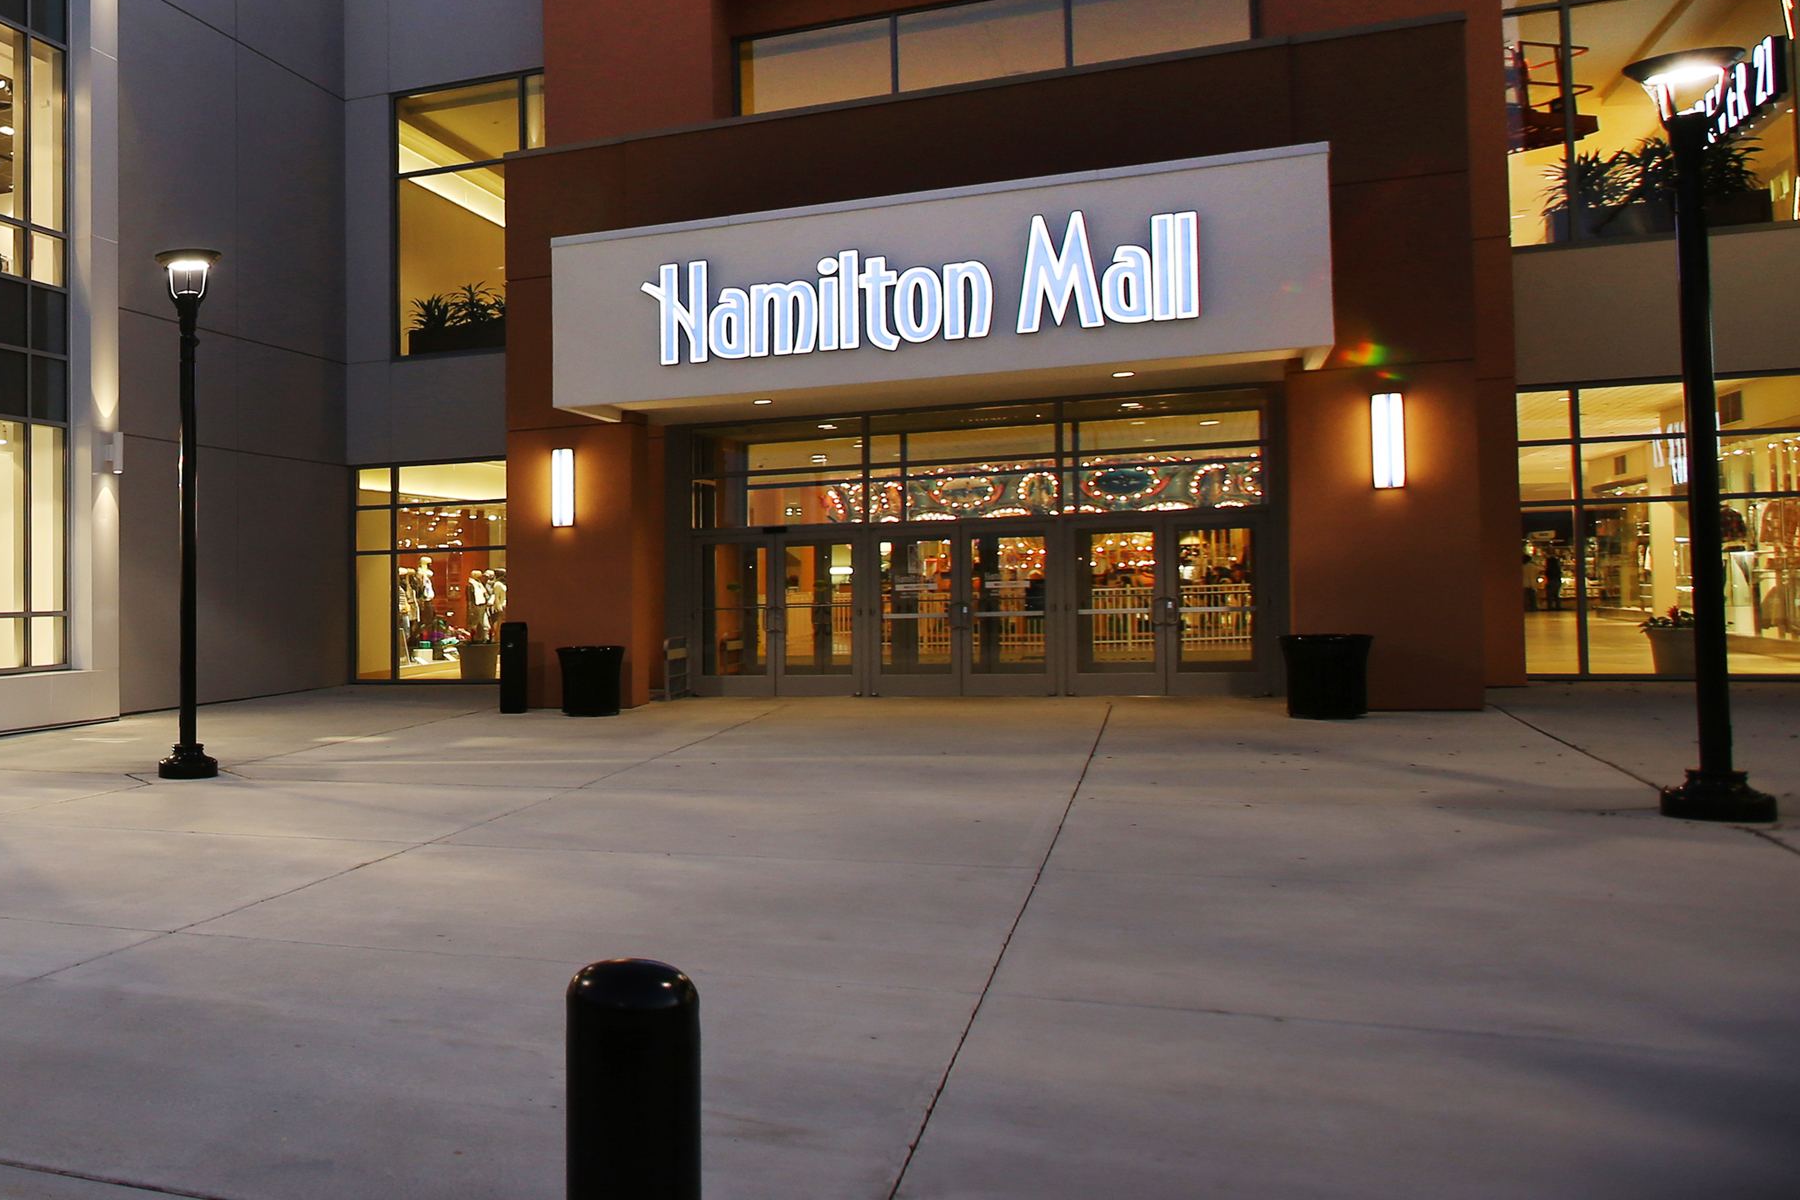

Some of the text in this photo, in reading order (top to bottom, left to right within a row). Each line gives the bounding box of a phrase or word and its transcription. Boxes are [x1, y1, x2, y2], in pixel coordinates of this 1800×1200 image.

[1752, 35, 1776, 107] 21
[641, 210, 1201, 366] Hamilton Mall
